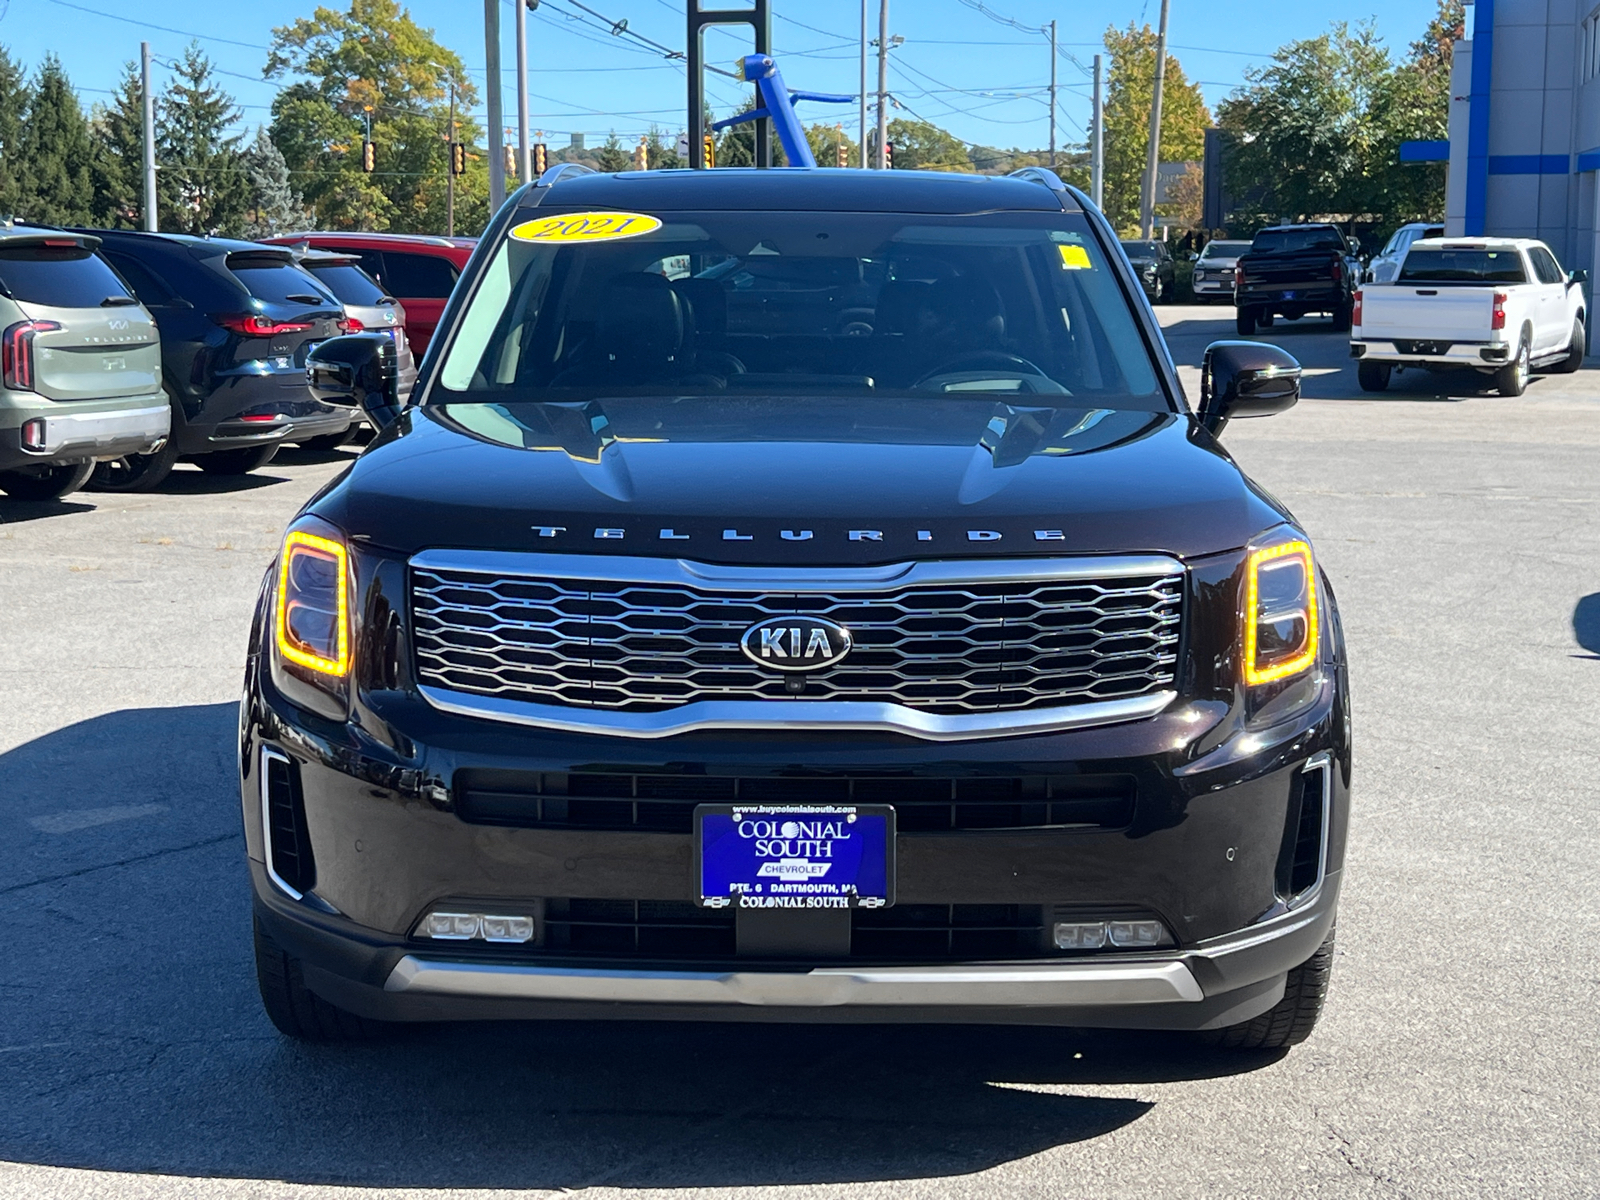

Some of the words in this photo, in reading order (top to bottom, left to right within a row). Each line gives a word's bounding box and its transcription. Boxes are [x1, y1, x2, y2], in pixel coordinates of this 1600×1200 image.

[532, 218, 637, 238] 2021
[531, 526, 1066, 541] TELLURIDE
[760, 628, 832, 658] KIA
[732, 805, 857, 815] www.buycolonialsouth.com
[738, 820, 851, 839] COLONIAL
[755, 840, 833, 857] SOUTH
[764, 864, 824, 874] CHEVROLET
[755, 884, 762, 892] 6
[770, 884, 839, 894] DARTMOUTH,
[740, 896, 806, 908] COLONIAL
[806, 896, 849, 908] SOUTH
